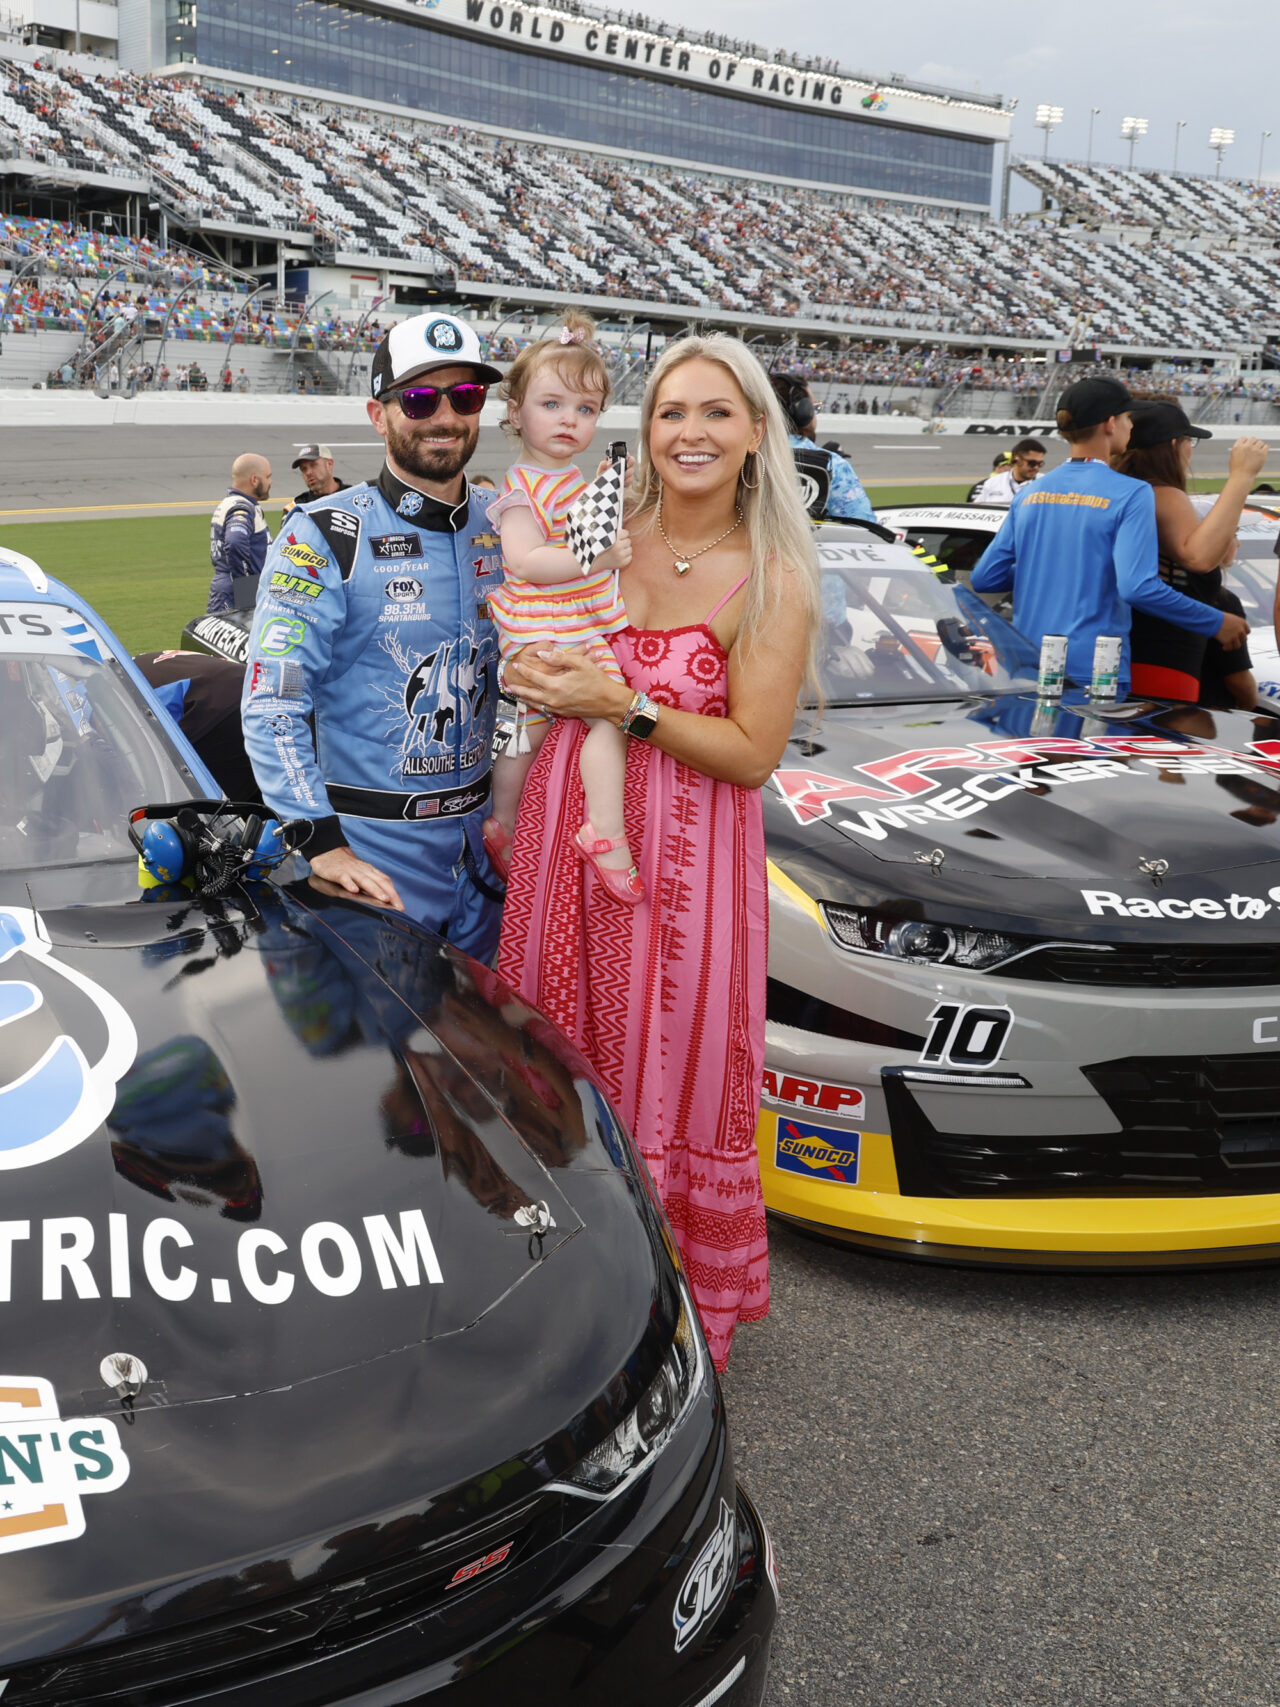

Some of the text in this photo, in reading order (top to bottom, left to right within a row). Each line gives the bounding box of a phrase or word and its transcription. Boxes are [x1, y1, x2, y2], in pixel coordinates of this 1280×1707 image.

[466, 0, 843, 104] WORLD CENTER OF RACING
[964, 424, 1059, 436] DAYT
[330, 525, 357, 538] SIMPSON
[281, 546, 325, 566] SUNOCO
[379, 542, 413, 555] xfinity
[823, 549, 886, 562] DYE
[271, 571, 325, 598] ELITE
[393, 580, 416, 593] FOX
[384, 602, 426, 616] 98.3FM
[838, 759, 1150, 841] WRECKER
[1080, 890, 1227, 919] Race
[1224, 893, 1272, 920] to
[918, 1001, 1015, 1069] 10
[761, 1070, 863, 1111] ARP
[781, 1139, 853, 1165] SUNOCO
[444, 1541, 514, 1590] SS
